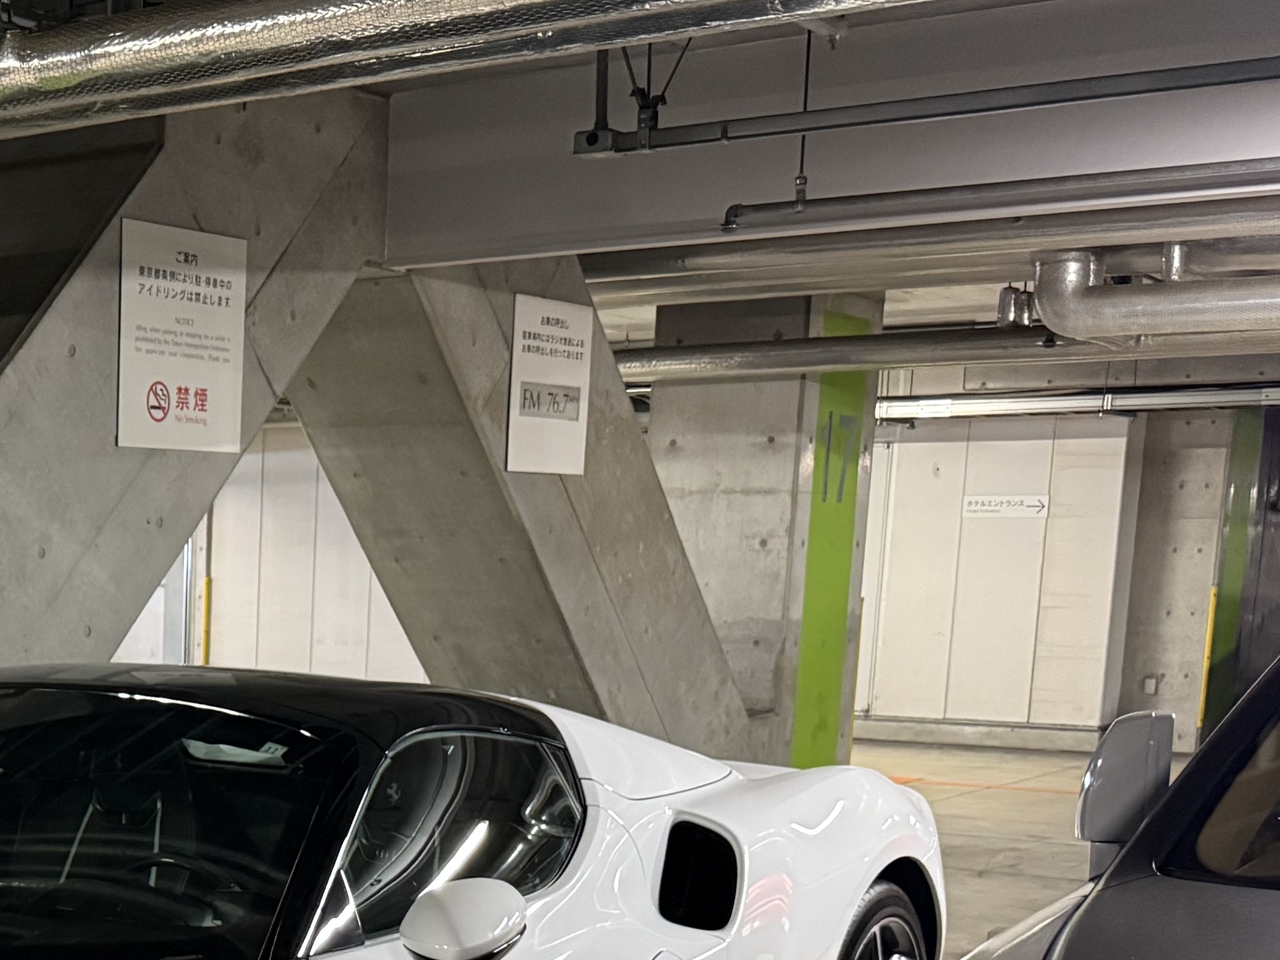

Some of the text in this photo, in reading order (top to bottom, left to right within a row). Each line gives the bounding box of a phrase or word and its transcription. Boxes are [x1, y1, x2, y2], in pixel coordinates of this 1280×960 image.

[175, 251, 198, 267] ご案内
[175, 386, 208, 412] 禁煙
[523, 389, 569, 414] FM 76.7
[821, 411, 857, 503] 17
